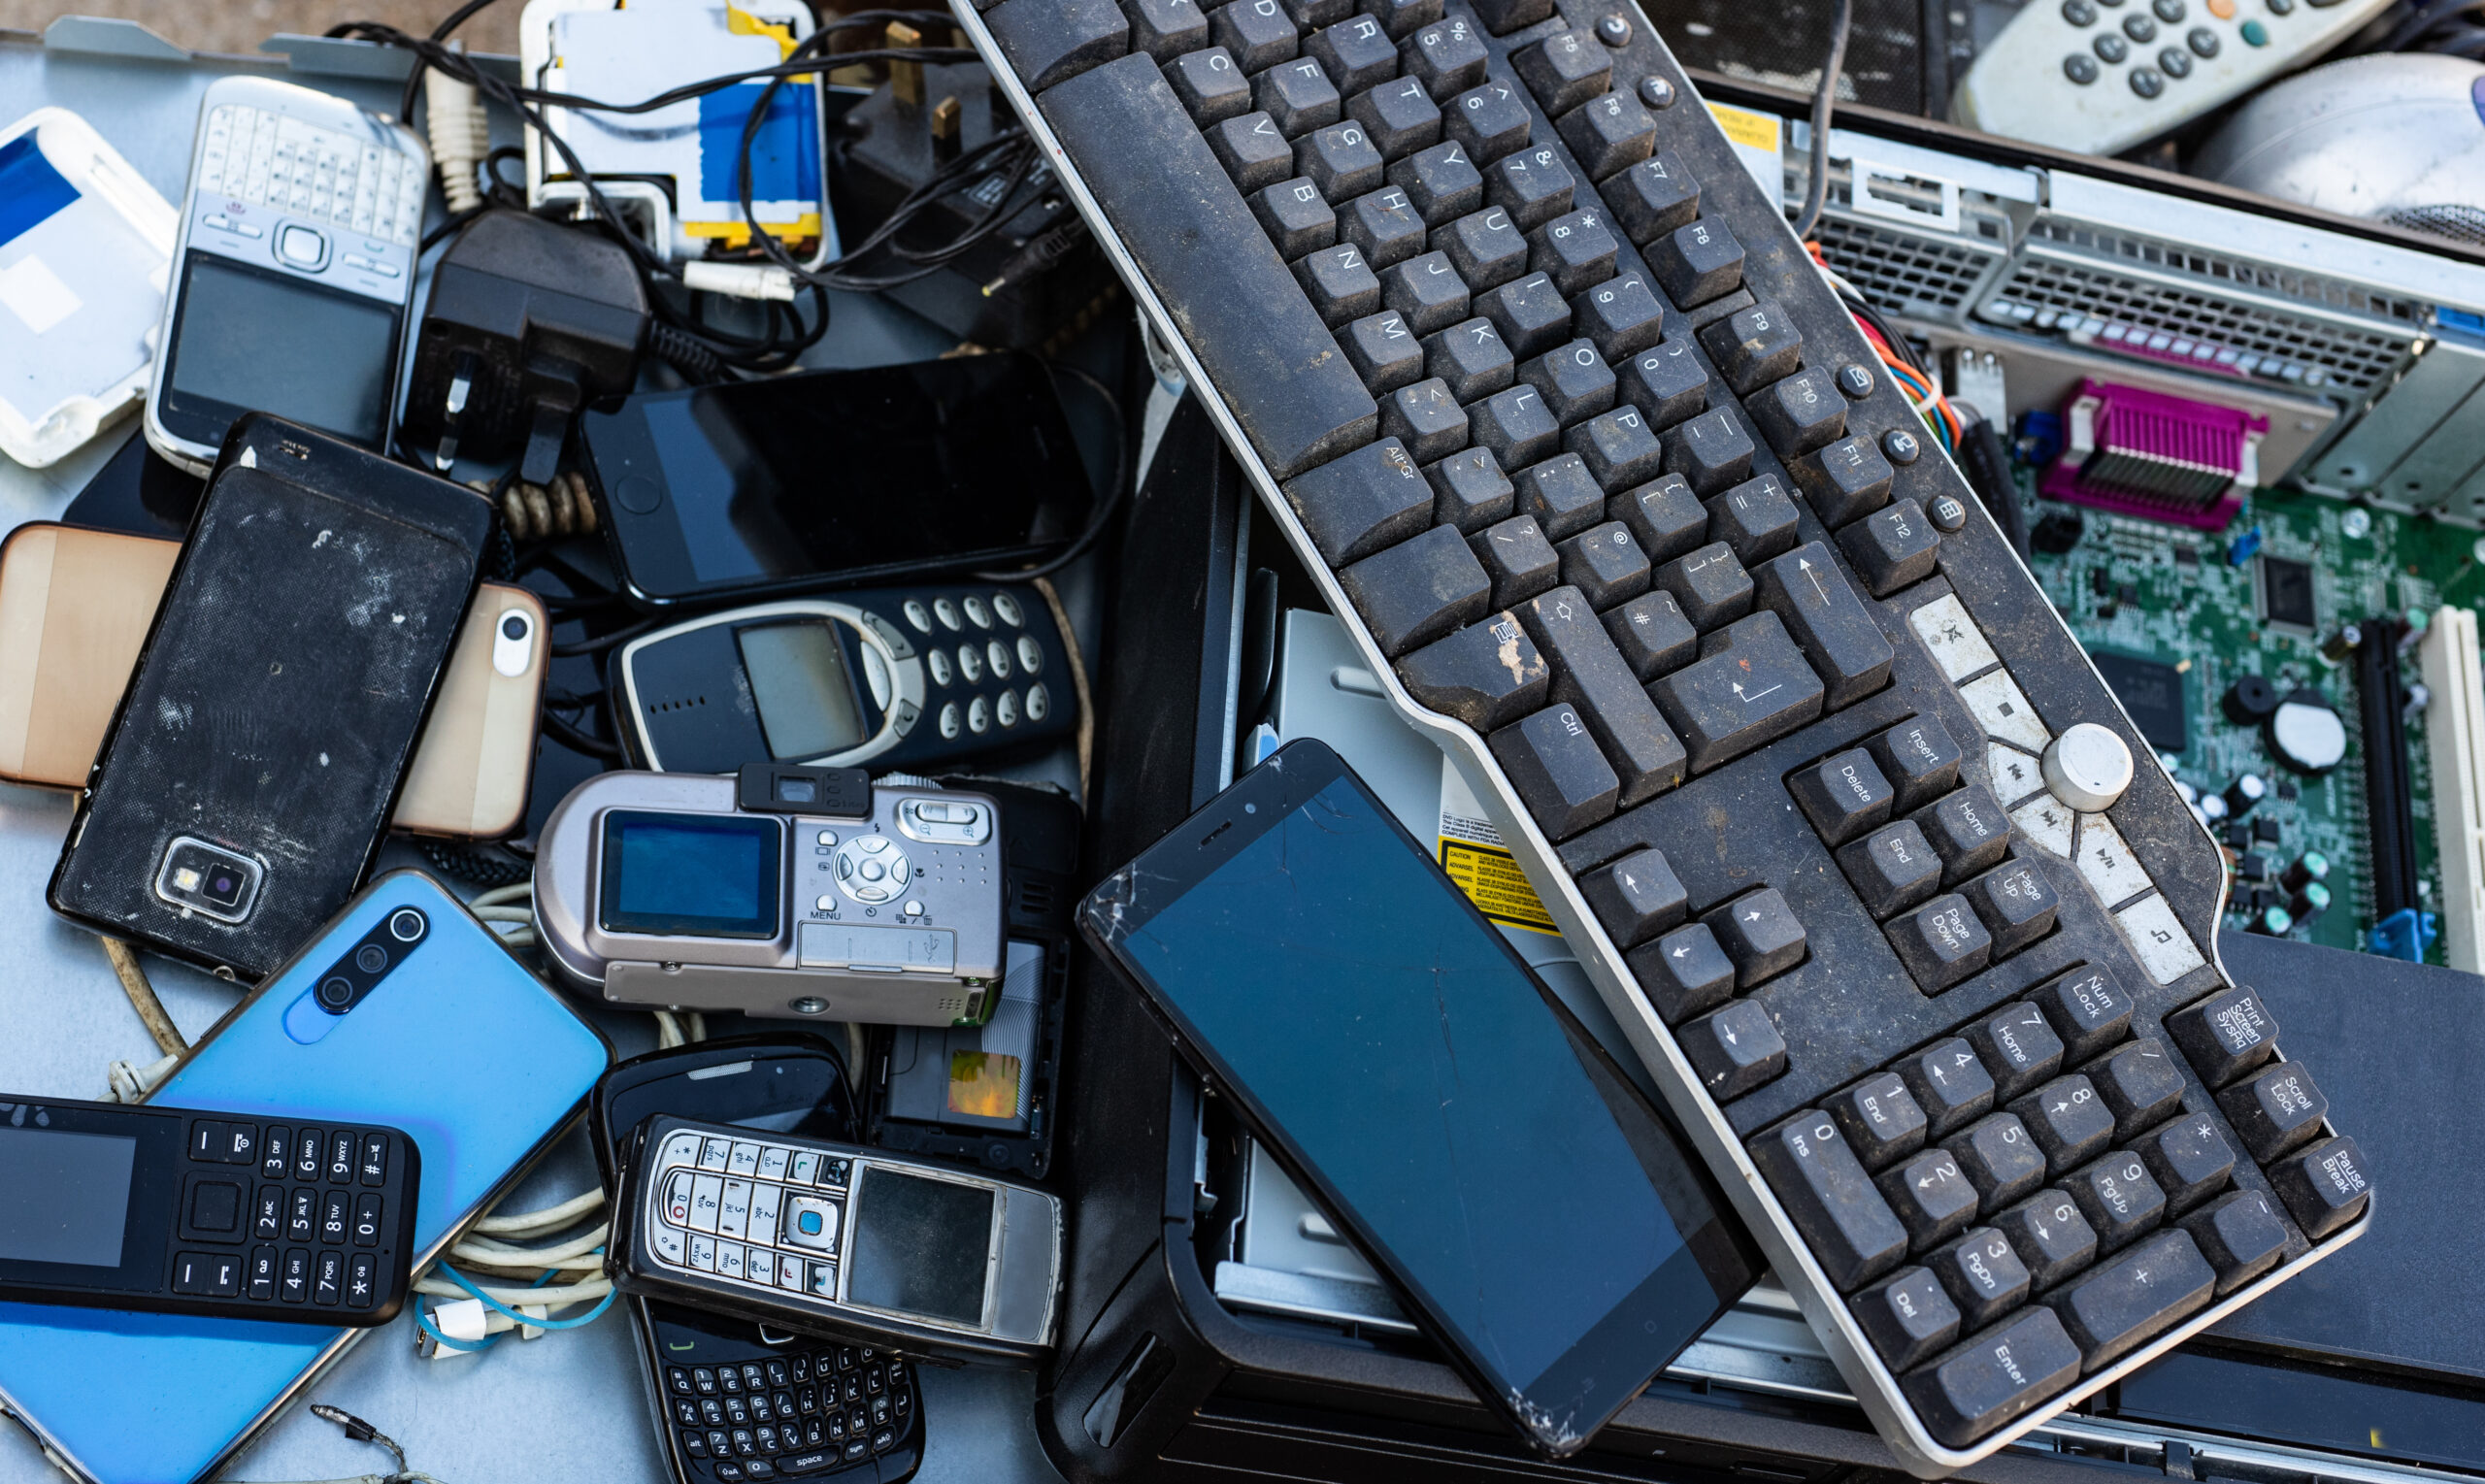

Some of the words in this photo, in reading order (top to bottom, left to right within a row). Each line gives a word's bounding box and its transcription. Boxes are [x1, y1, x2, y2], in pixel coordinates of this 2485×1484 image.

[1255, 0, 1276, 16] D
[1353, 20, 1376, 40] R
[1424, 32, 1441, 47] 5
[1562, 34, 1578, 52] F5
[1209, 54, 1228, 72] C
[1296, 63, 1318, 79] F
[1400, 84, 1421, 98] T
[1468, 97, 1483, 110] 6
[1605, 97, 1621, 115] F6
[1253, 118, 1275, 137] V
[1342, 128, 1362, 146] G
[1443, 148, 1464, 165] Y
[1509, 160, 1526, 174] 7
[1649, 160, 1668, 181] F7
[1294, 184, 1314, 202] B
[1383, 192, 1407, 210] H
[1486, 213, 1508, 231] U
[1555, 226, 1571, 238] 8
[1692, 225, 1709, 245] F8
[1338, 250, 1361, 269] N
[1428, 263, 1448, 275] J
[1599, 291, 1614, 303] 9
[1381, 317, 1406, 339] M
[1751, 312, 1770, 331] F9
[1471, 325, 1494, 345] K
[1796, 379, 1817, 404] F10
[1516, 393, 1534, 410] L
[1617, 412, 1639, 428] P
[1842, 445, 1863, 467] F11
[1888, 512, 1911, 539] F12
[1560, 711, 1583, 738] Ctrl
[1908, 728, 1939, 764] Insert
[1841, 765, 1872, 803] Delete
[1959, 802, 1988, 838] Home
[1450, 851, 1471, 860] CAUTION
[1889, 838, 1912, 865] End
[2003, 877, 2019, 898] Up
[2017, 871, 2041, 901] Page
[811, 911, 841, 920] MENU
[1945, 907, 1970, 940] Page
[1932, 914, 1960, 952] Down
[2086, 975, 2113, 1008] Num
[2072, 983, 2100, 1019] Lock
[2021, 1011, 2041, 1026] 7
[2238, 997, 2265, 1028] Print
[2217, 1011, 2247, 1049] SysRq
[2231, 1005, 2262, 1043] Screen
[1998, 1025, 2028, 1064] Home
[1955, 1052, 1973, 1068] 4
[2071, 1088, 2091, 1104] 8
[2270, 1083, 2297, 1116] Lock
[2284, 1076, 2313, 1110] Scroll
[1863, 1096, 1886, 1124] End
[2002, 1126, 2023, 1144] 5
[306, 1139, 315, 1158] MNO
[339, 1140, 348, 1162] WXYZ
[1791, 1135, 1810, 1158] Ins
[267, 1158, 282, 1170] 3
[300, 1160, 315, 1172] 6
[333, 1163, 348, 1174] 9
[1936, 1163, 1956, 1182] 2
[2123, 1165, 2141, 1180] 9
[2335, 1150, 2366, 1189] Pause
[2322, 1159, 2350, 1195] Break
[2101, 1177, 2129, 1214] PgUp
[298, 1204, 307, 1217] JKL
[331, 1204, 340, 1219] TUV
[2055, 1204, 2073, 1221] 6
[260, 1217, 277, 1229] 2
[293, 1219, 309, 1231] 5
[326, 1221, 343, 1233] 8
[1987, 1240, 2006, 1258] 3
[292, 1260, 301, 1274] GHI
[325, 1260, 335, 1280] PQRS
[1967, 1252, 1996, 1290] PgDn
[254, 1277, 271, 1286] 1
[286, 1277, 302, 1289] 4
[319, 1280, 335, 1291] 7
[1896, 1293, 1918, 1318] Del
[1994, 1344, 2027, 1386] Enter
[760, 1409, 768, 1418] F
[804, 1401, 812, 1409] H
[855, 1419, 864, 1428] M
[797, 1456, 822, 1466] space
